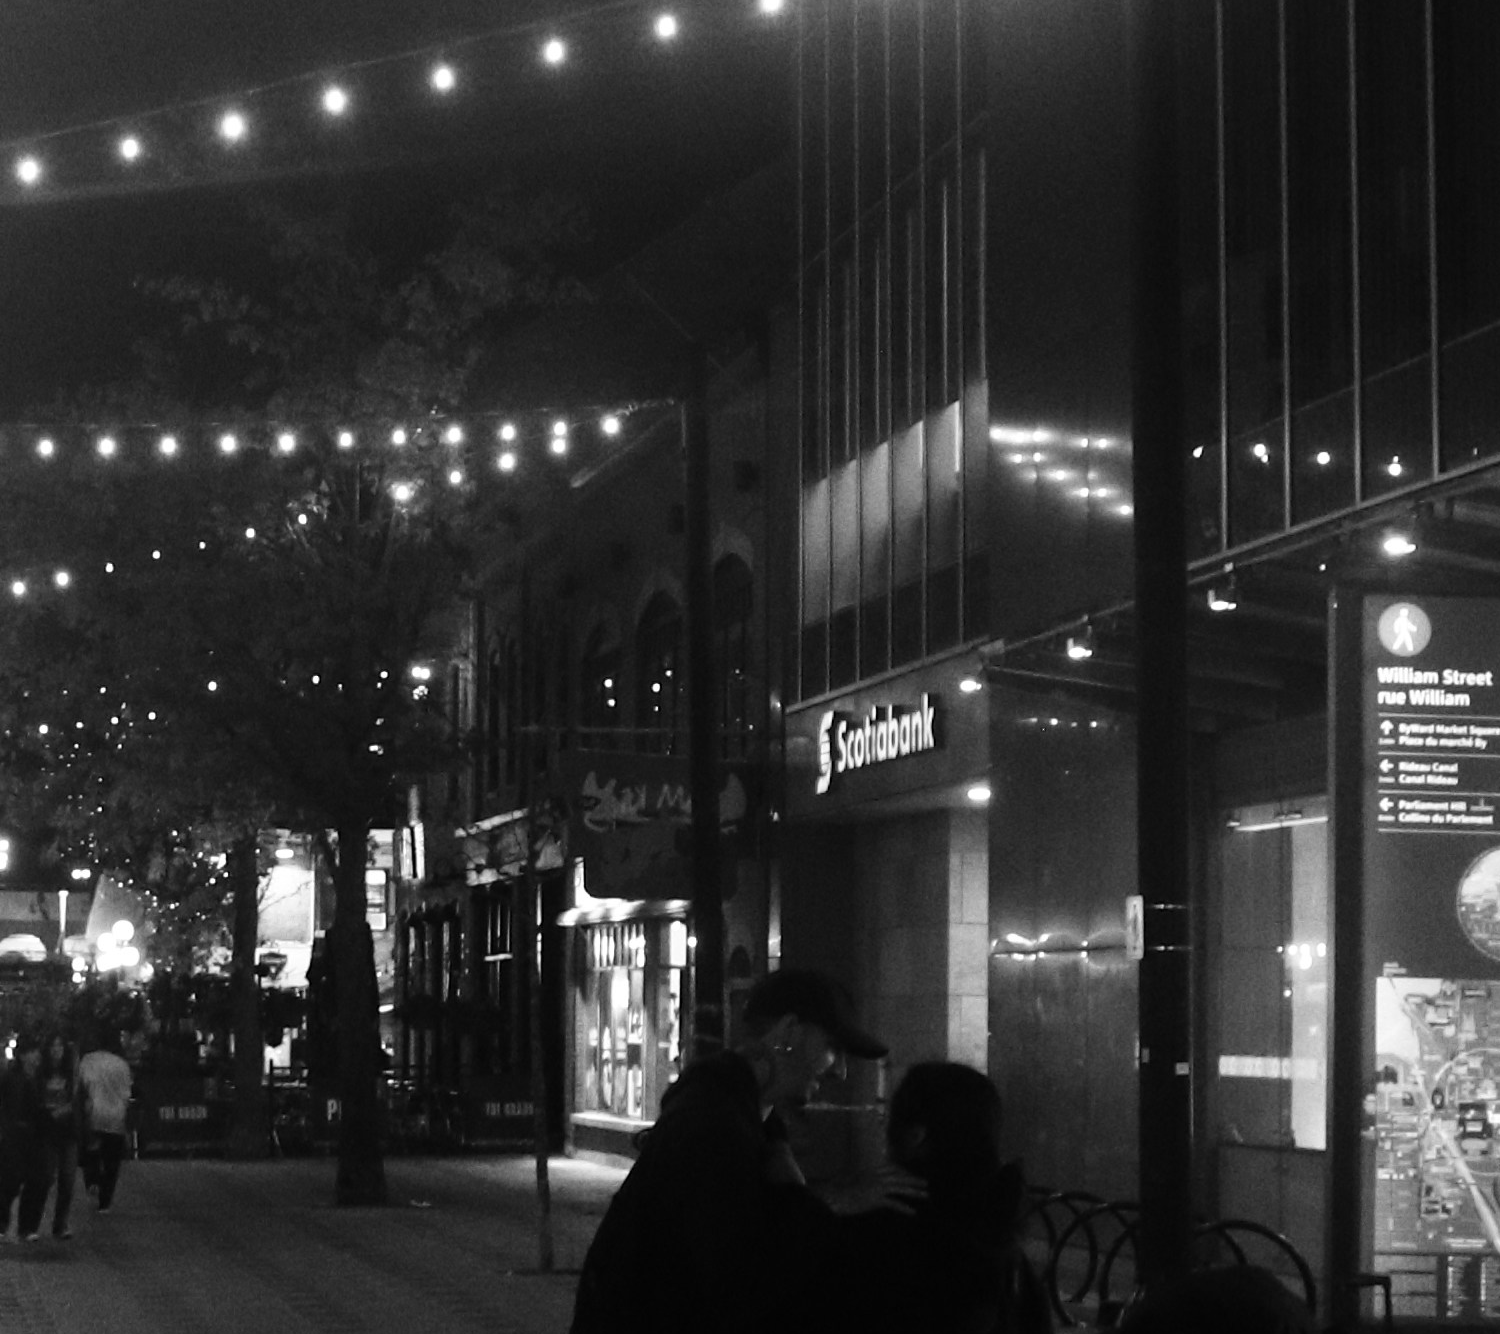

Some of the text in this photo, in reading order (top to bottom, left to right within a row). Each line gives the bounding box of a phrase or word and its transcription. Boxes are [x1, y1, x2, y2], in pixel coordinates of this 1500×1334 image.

[1377, 667, 1493, 686] William Street
[1377, 688, 1470, 707] rue William
[837, 692, 936, 774] Scotiabank
[1436, 723, 1468, 735] Market
[1432, 762, 1459, 773] Canal
[1398, 773, 1426, 785] Canal
